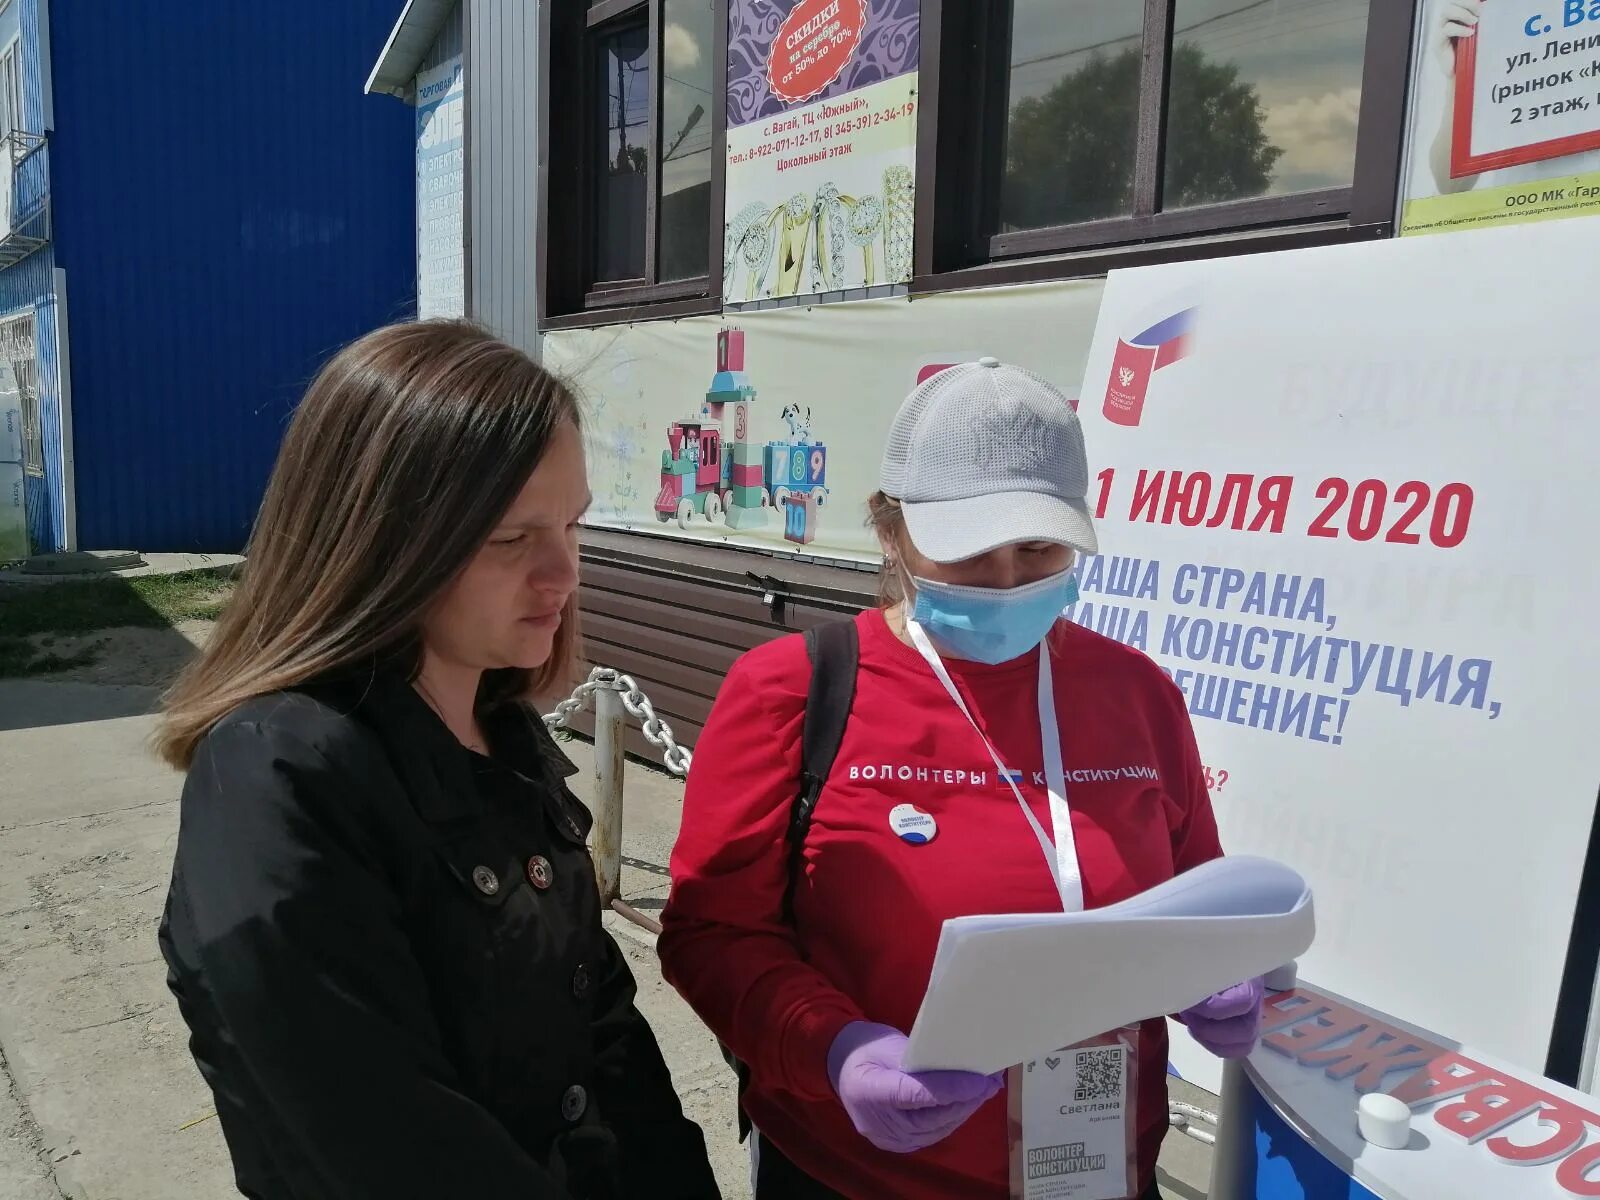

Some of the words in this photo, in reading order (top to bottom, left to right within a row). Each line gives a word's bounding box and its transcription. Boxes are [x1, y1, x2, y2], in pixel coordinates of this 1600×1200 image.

[785, 1, 840, 49] СКИДКИ
[789, 50, 801, 64] на
[802, 20, 841, 53] серебро
[1524, 14, 1552, 36] с.
[782, 71, 793, 84] от
[795, 56, 815, 75] 50%
[817, 45, 829, 61] до
[831, 27, 852, 48] 70%
[1506, 52, 1537, 74] ул.
[1491, 69, 1574, 104] (рынок
[763, 126, 771, 137] с.
[772, 116, 800, 134] Вагай,
[802, 111, 815, 126] ТЦ
[816, 97, 869, 121] «Южный»,
[1510, 107, 1522, 124] 2
[1528, 95, 1590, 120] этаж,
[729, 152, 748, 165] тел.:
[749, 130, 822, 161] 8-922-071-12-17,
[835, 116, 871, 138] 345-39)
[873, 102, 915, 126] 2-34-19
[777, 147, 828, 172] Цокольный
[829, 142, 853, 159] этаж
[1505, 192, 1538, 207] ООО
[1541, 189, 1564, 202] МК
[736, 405, 746, 440] 3
[775, 451, 788, 481] 7
[792, 450, 806, 481] 8
[810, 450, 823, 482] 9
[786, 503, 805, 538] 10
[1128, 469, 1294, 534] ИЮЛЯ
[1307, 477, 1474, 548] 2020
[1172, 563, 1337, 632] СТРАНА,
[1160, 614, 1503, 719] КОНСТИТУЦИЯ,
[849, 765, 987, 785] ВОЛОНТЕРЫ
[1059, 1101, 1120, 1115] Светлана
[1029, 1143, 1083, 1164] ВОЛОНТЕР
[1029, 1154, 1105, 1178] КОНСТИТУЦИИ
